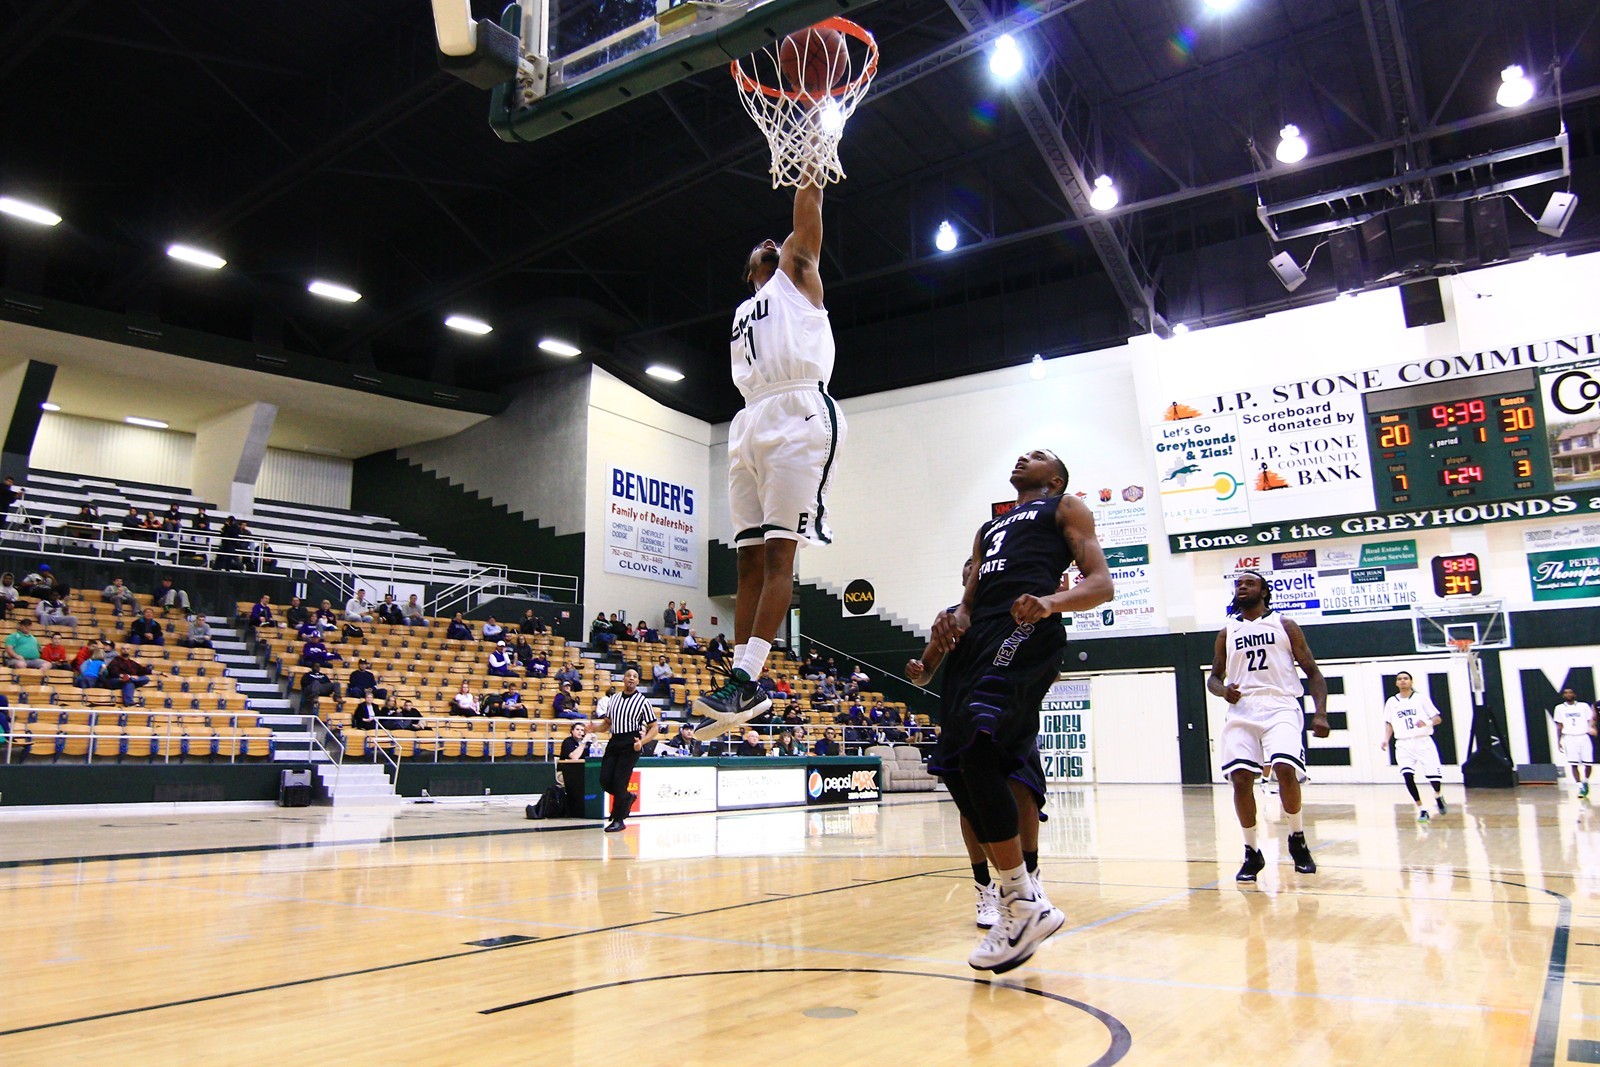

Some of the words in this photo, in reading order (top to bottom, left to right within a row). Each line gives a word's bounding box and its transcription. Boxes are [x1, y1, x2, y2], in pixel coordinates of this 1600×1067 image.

[1212, 391, 1258, 414] J.P.
[1272, 369, 1382, 405] STONE
[1397, 333, 1600, 383] COMMUNI
[1243, 402, 1331, 425] Scoreboard
[1432, 400, 1486, 428] 9:39
[1503, 406, 1534, 432] 30
[1193, 424, 1211, 434] Go
[1268, 418, 1332, 433] donated
[1337, 413, 1355, 424] by
[1156, 433, 1236, 453] Greyhounds
[1381, 424, 1411, 448] 20
[1480, 427, 1487, 442] 1
[1186, 452, 1196, 460] &
[1200, 446, 1233, 459] Zias!
[1251, 446, 1281, 461] J.P.
[1289, 435, 1358, 456] STONE
[1278, 452, 1360, 470] COMMUNITY
[1518, 460, 1531, 477] 3
[1297, 463, 1362, 486] BANK
[1395, 475, 1408, 490] 7
[612, 468, 694, 515] BENDER'S
[611, 503, 639, 522] Family
[639, 511, 649, 522] of
[650, 512, 694, 534] Dealerships
[1177, 534, 1249, 550] Home
[1257, 530, 1281, 543] of
[1290, 523, 1332, 539] the
[1341, 495, 1577, 534] GREYHOUNDS
[986, 530, 1007, 557] 3
[1235, 557, 1260, 568] ACE
[1443, 558, 1476, 573] 9:39
[1569, 558, 1600, 567] PETER
[1111, 568, 1145, 579] mino's
[1267, 573, 1316, 592] sevelt
[1533, 561, 1600, 586] Thomps
[845, 591, 874, 603] NCAA
[1114, 587, 1151, 601] OPRACTIC
[1276, 590, 1316, 601] Hospital
[1331, 587, 1346, 596] YOU
[1350, 584, 1372, 594] CAN'T
[1376, 583, 1389, 592] GET
[1393, 582, 1408, 591] ANY
[1323, 597, 1360, 609] CLOSER
[1363, 593, 1391, 606] THAN
[1235, 632, 1275, 651] ENMU
[1247, 649, 1269, 672] 22
[1042, 701, 1083, 710] ENMU
[1397, 709, 1417, 718] ENMU
[1405, 717, 1415, 730] 13
[824, 774, 851, 793] pepsi
